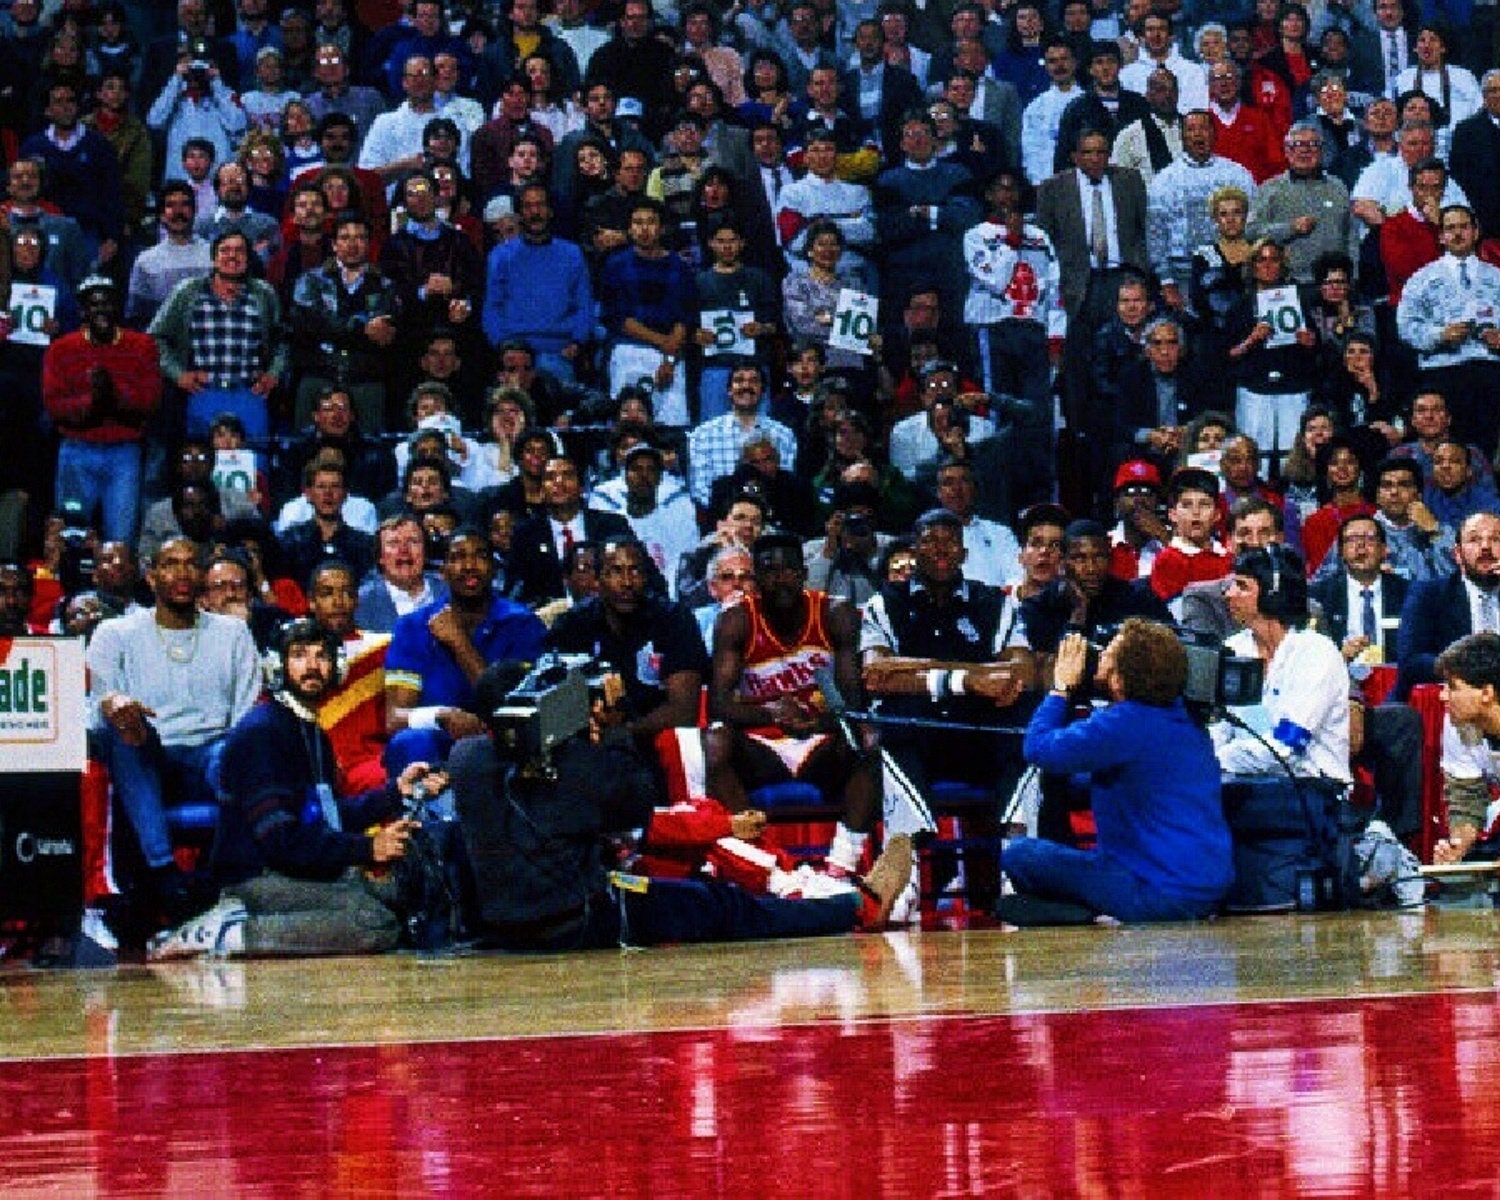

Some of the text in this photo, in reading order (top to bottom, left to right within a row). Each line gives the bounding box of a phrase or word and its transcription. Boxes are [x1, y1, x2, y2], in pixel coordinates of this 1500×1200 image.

[13, 304, 50, 333] 10
[836, 310, 873, 341] 10
[1262, 305, 1301, 334] 10
